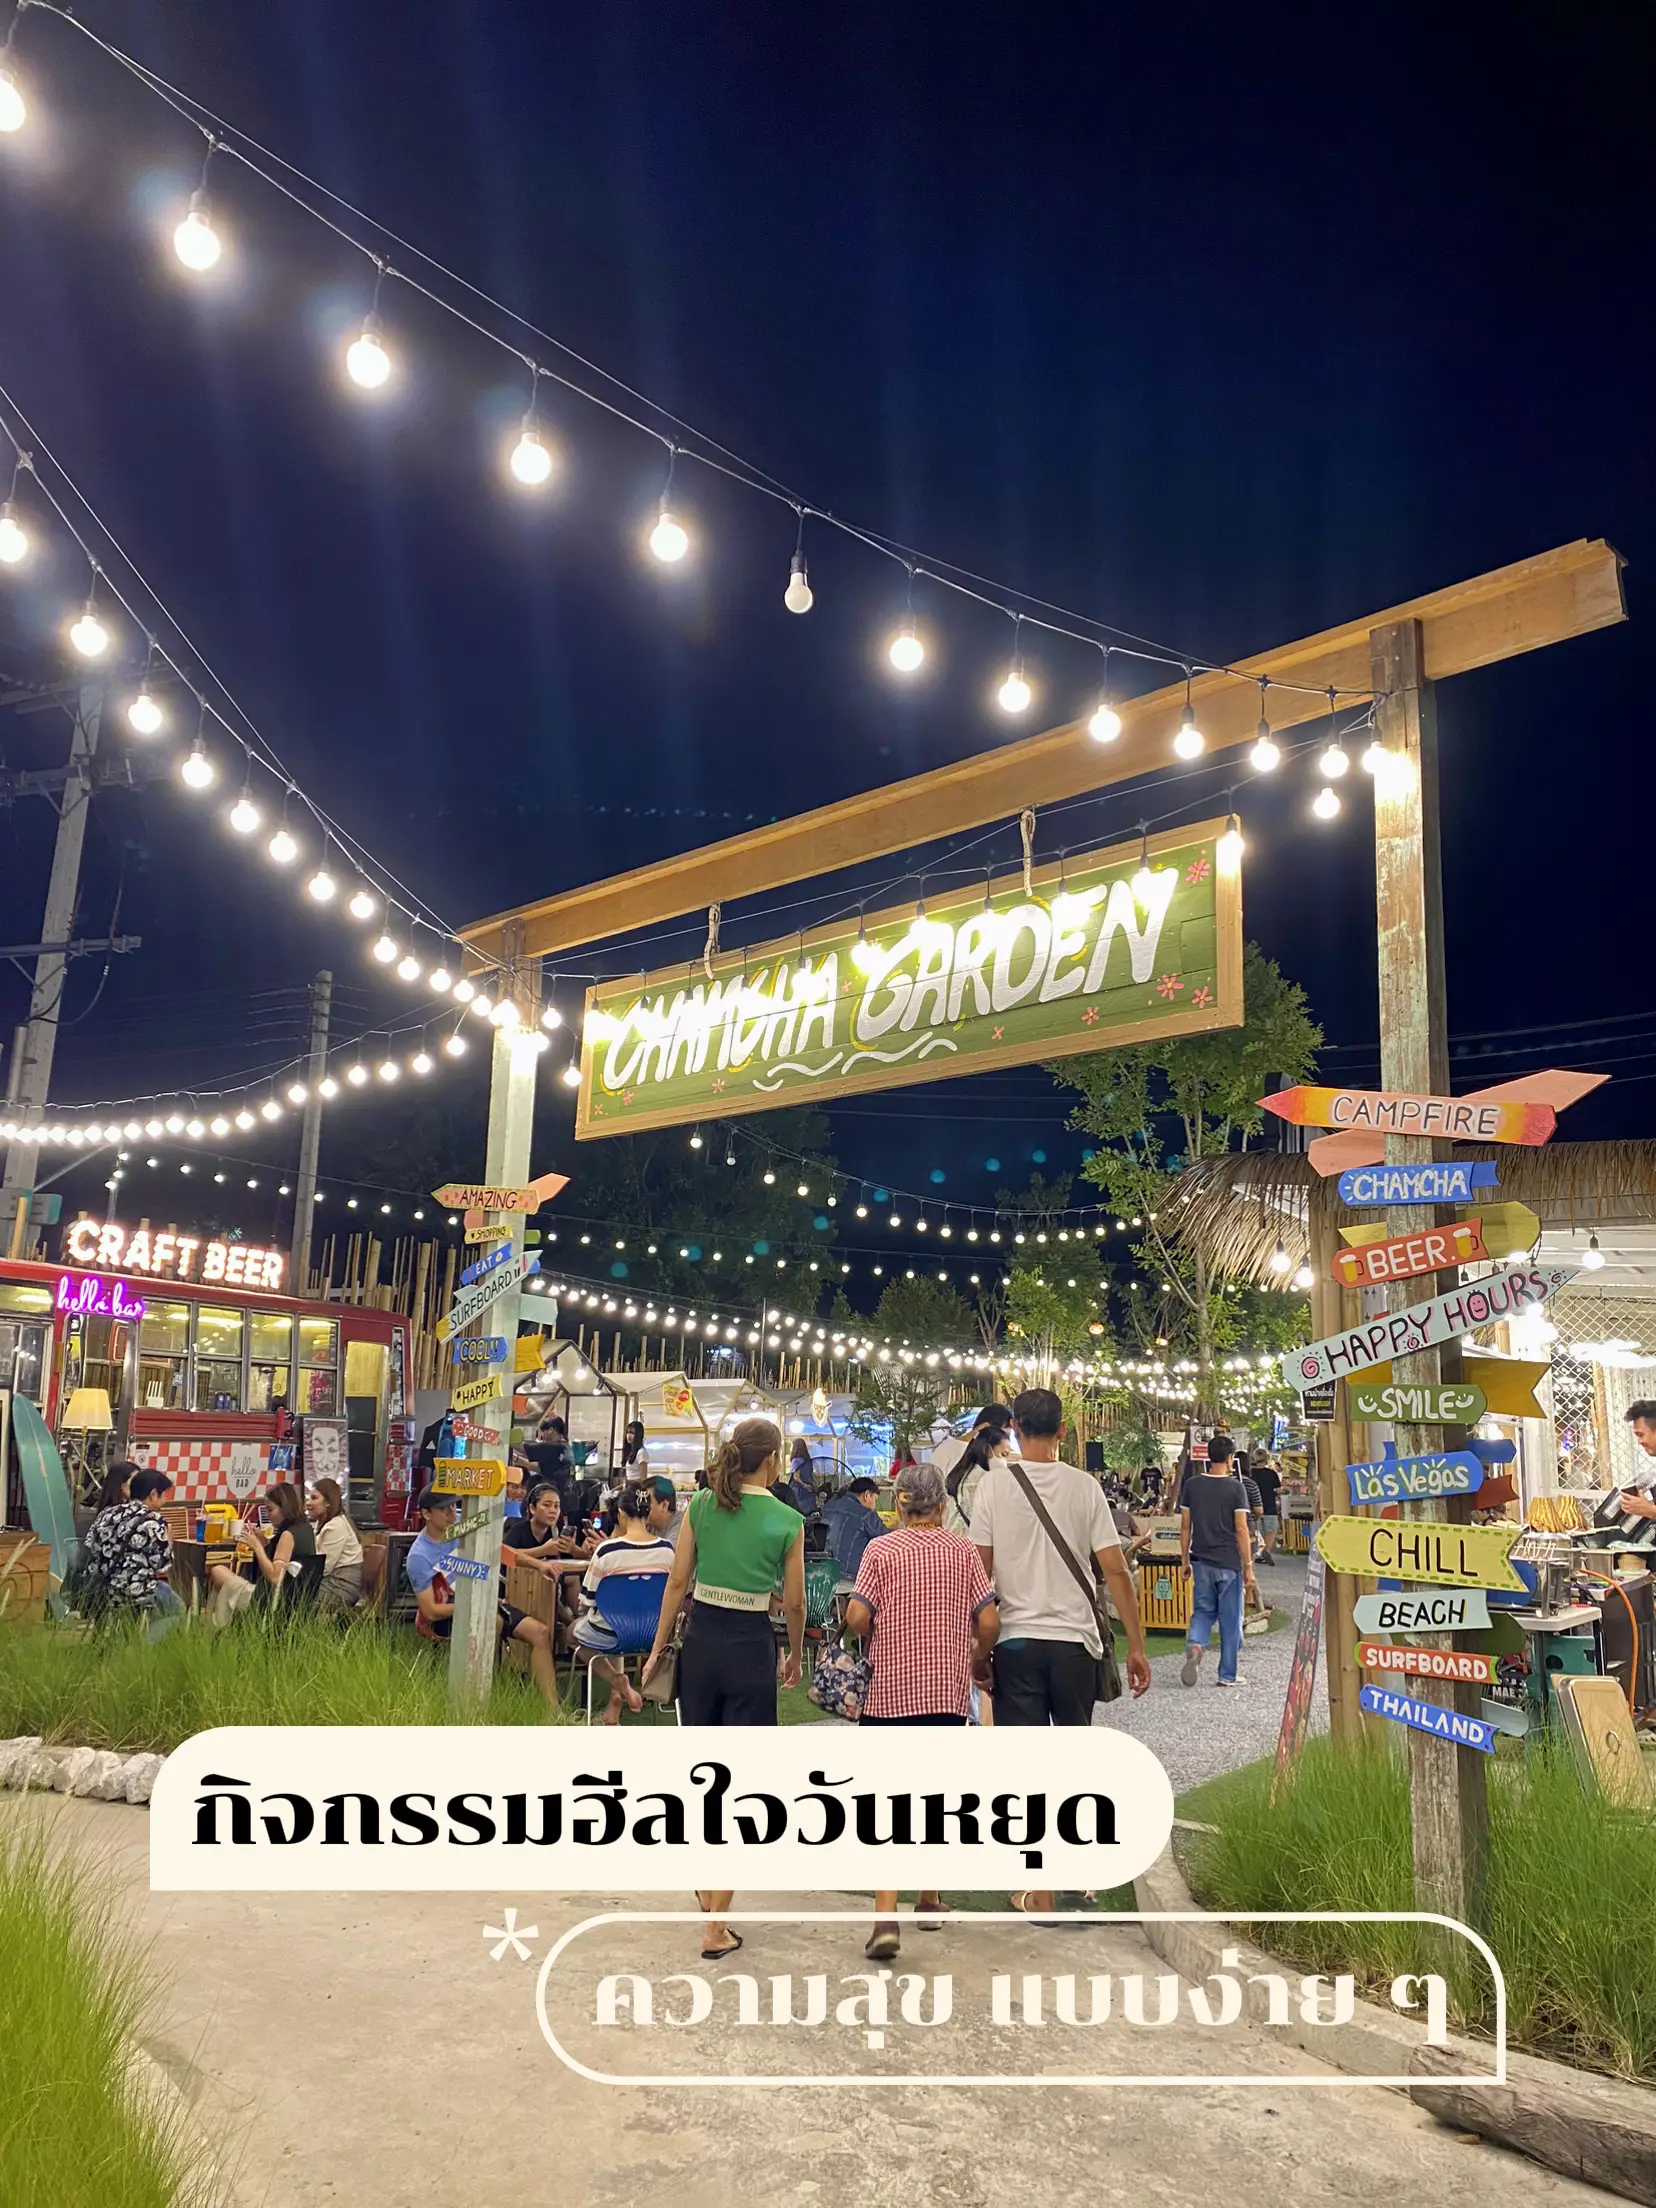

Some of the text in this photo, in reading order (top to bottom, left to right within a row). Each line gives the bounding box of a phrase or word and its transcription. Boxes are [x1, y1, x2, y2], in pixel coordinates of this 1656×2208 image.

[855, 867, 1179, 1041] GARDEN
[1333, 1096, 1499, 1135] CAMPFIRE
[1353, 1169, 1468, 1201] CHAMCHA
[459, 1191, 518, 1210] AMAZING
[476, 1226, 506, 1240] SHOPPING
[67, 1219, 284, 1289] CRAFT BEER
[475, 1255, 494, 1275] EAT
[57, 1275, 143, 1318] hello bar
[450, 1270, 512, 1331] SURFBOARD
[1324, 1269, 1549, 1374] HAPPY HOURS
[462, 1377, 495, 1405] HAPPY
[1377, 1387, 1457, 1418] SMILE
[464, 1424, 483, 1439] GOOD
[230, 1455, 258, 1477] hello
[445, 1467, 496, 1489] MARKET
[1355, 1458, 1470, 1500] Las Vegas
[235, 1478, 249, 1489] BAR
[454, 1517, 478, 1537] MUSIC
[447, 1558, 477, 1576] SUNNY
[1369, 1528, 1478, 1577] CHILL
[700, 1587, 756, 1607] GENTLEWOMAN
[1378, 1598, 1466, 1628] BEACH
[1366, 1648, 1488, 1680] SURFBOARD
[1370, 1690, 1484, 1744] THAILAND
